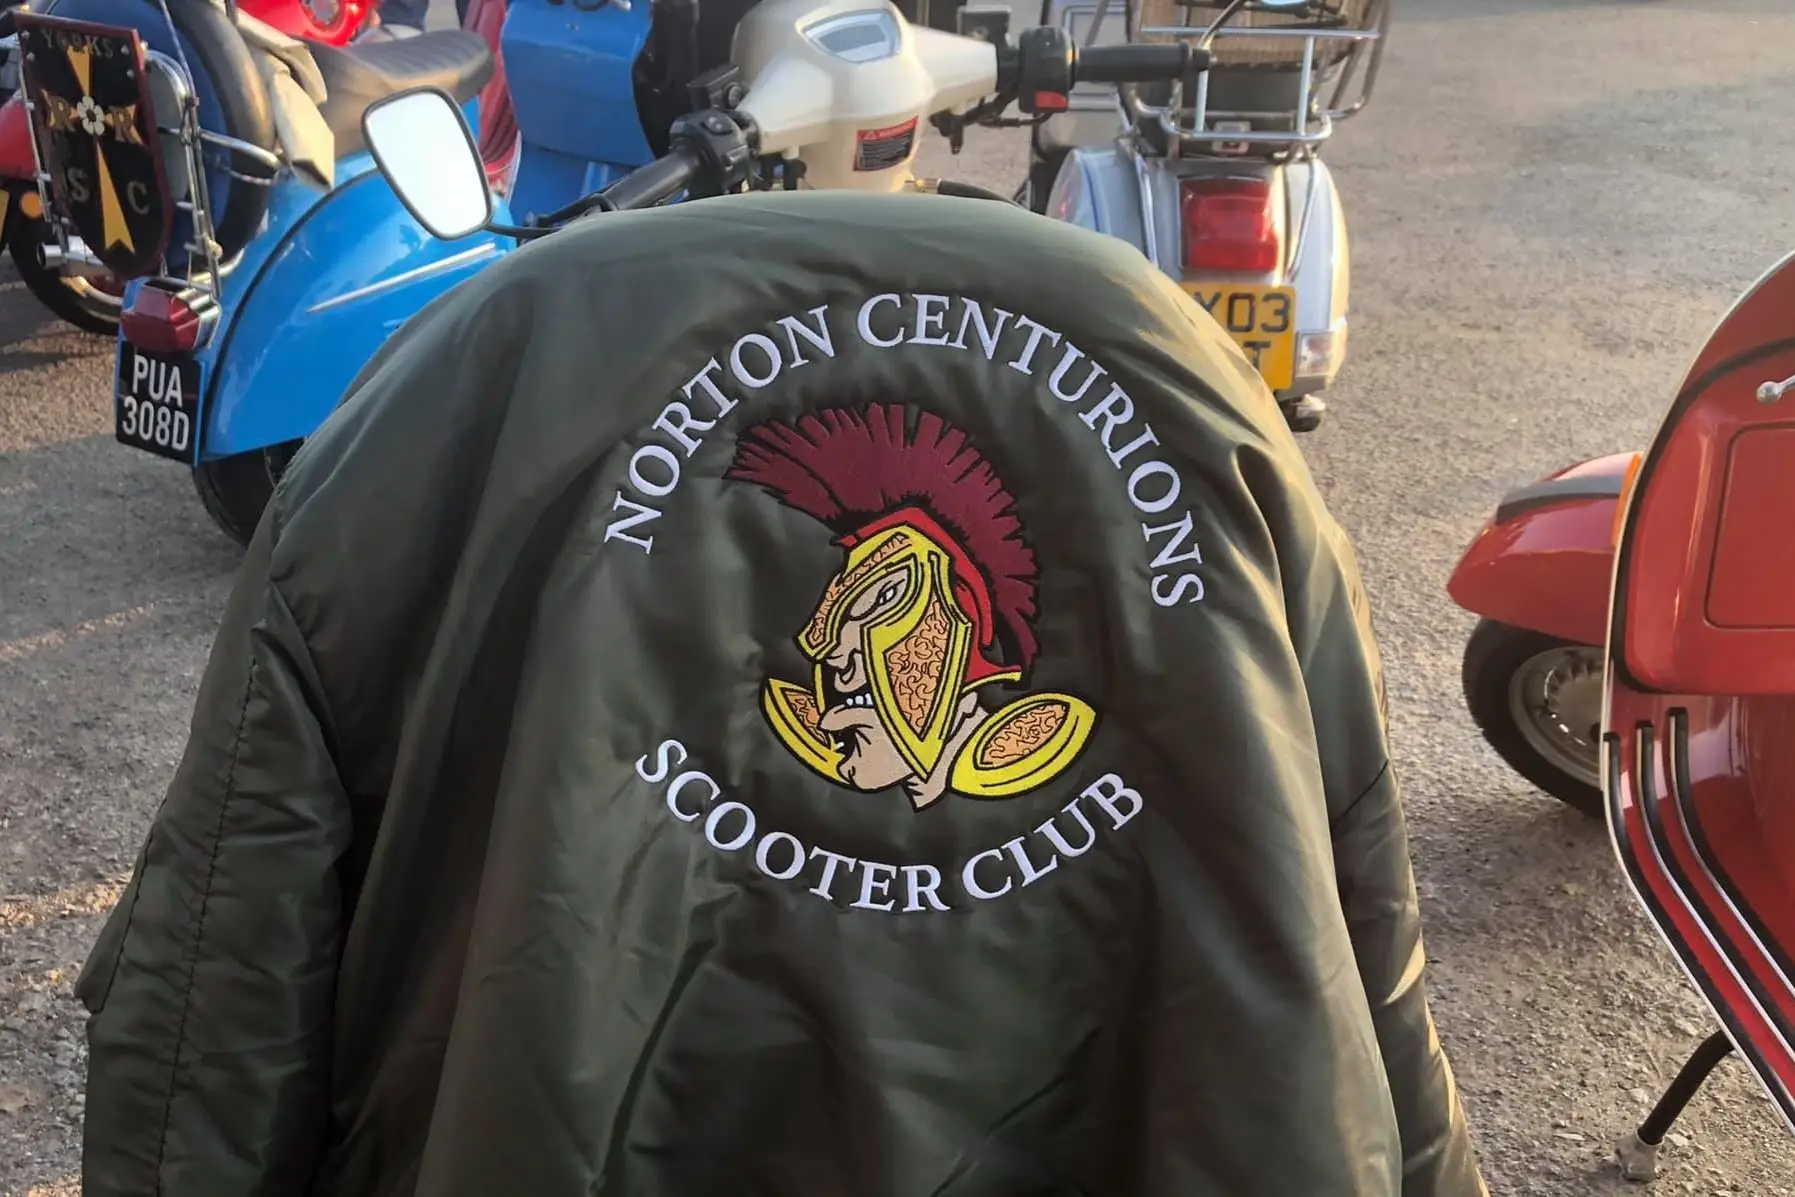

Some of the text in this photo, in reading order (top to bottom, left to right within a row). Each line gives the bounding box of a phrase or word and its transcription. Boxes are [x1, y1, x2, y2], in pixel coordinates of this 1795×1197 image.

[108, 106, 138, 144] R
[67, 166, 150, 215] S C
[132, 354, 183, 408] PUA
[122, 396, 190, 451] 308D
[603, 293, 1206, 608] NORTON CENTURIONS
[635, 739, 1144, 913] SCOOTER CLUB
